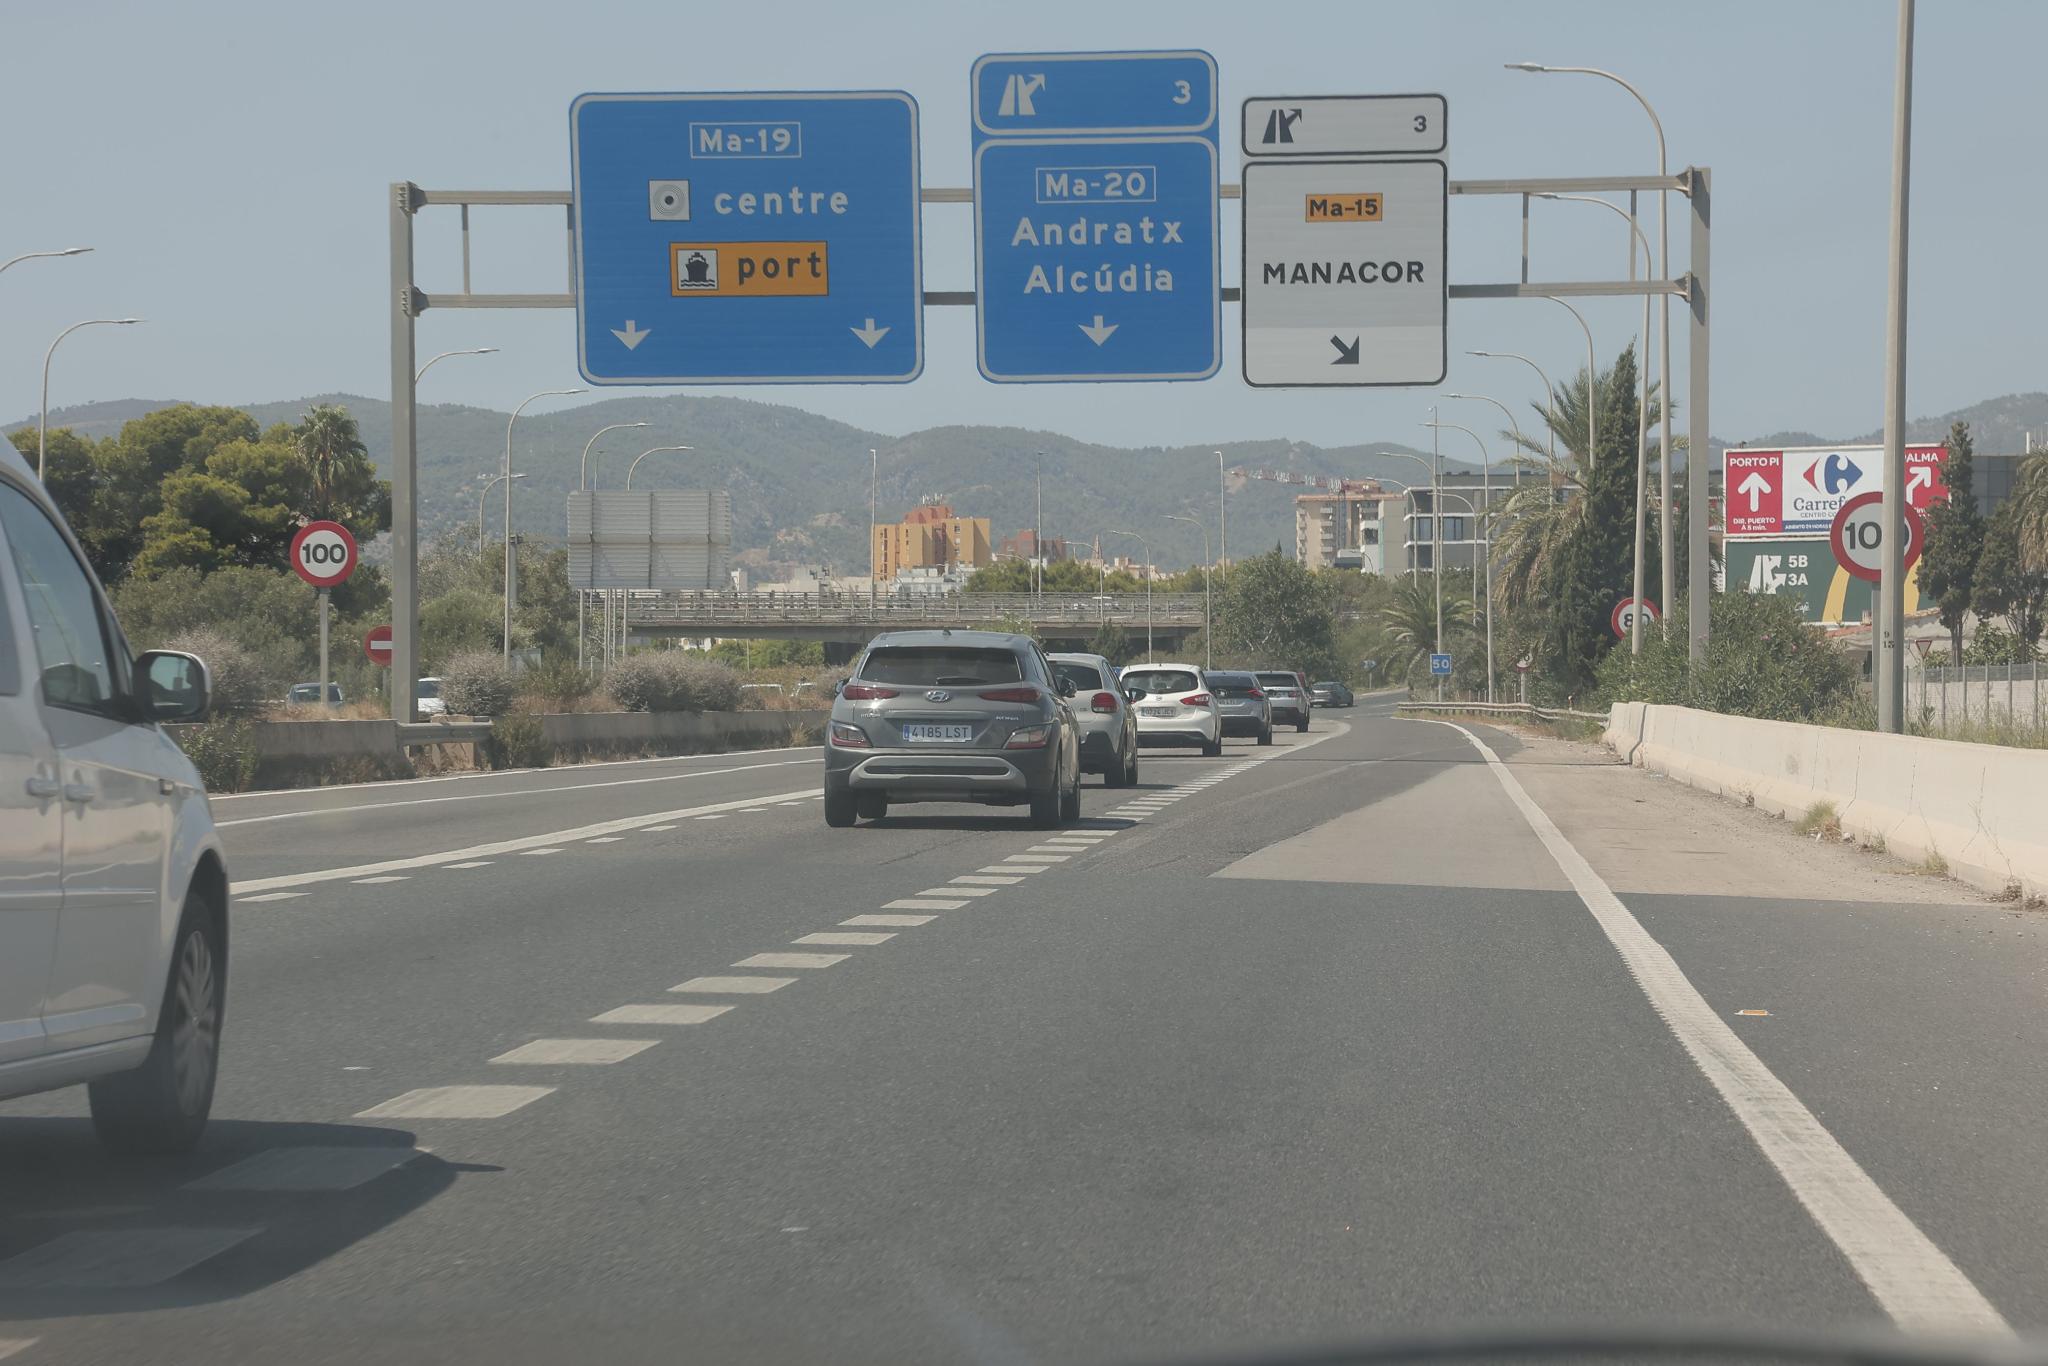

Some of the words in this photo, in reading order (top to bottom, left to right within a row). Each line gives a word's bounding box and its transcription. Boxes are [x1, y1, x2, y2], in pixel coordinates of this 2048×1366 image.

[1172, 80, 1191, 104] 3
[1413, 115, 1427, 132] 3
[700, 127, 791, 152] Ma-19
[1045, 172, 1146, 197] Ma-20
[714, 187, 849, 215] centre
[1309, 198, 1378, 217] Ma-15
[1011, 216, 1183, 247] Andratx
[737, 252, 822, 284] port
[1023, 263, 1174, 294] Alcúdia
[1263, 261, 1425, 284] MANACOR
[1730, 457, 1767, 467] PORTO
[1769, 457, 1779, 466] PI
[1905, 452, 1939, 463] ALMA
[1793, 496, 1846, 511] Carref
[1845, 521, 1909, 549] 10
[302, 543, 345, 564] 100
[1788, 555, 1808, 568] 5B
[1788, 573, 1808, 586] 3A
[1432, 659, 1449, 669] 50
[912, 727, 942, 738] 4185
[945, 727, 968, 738] LST
